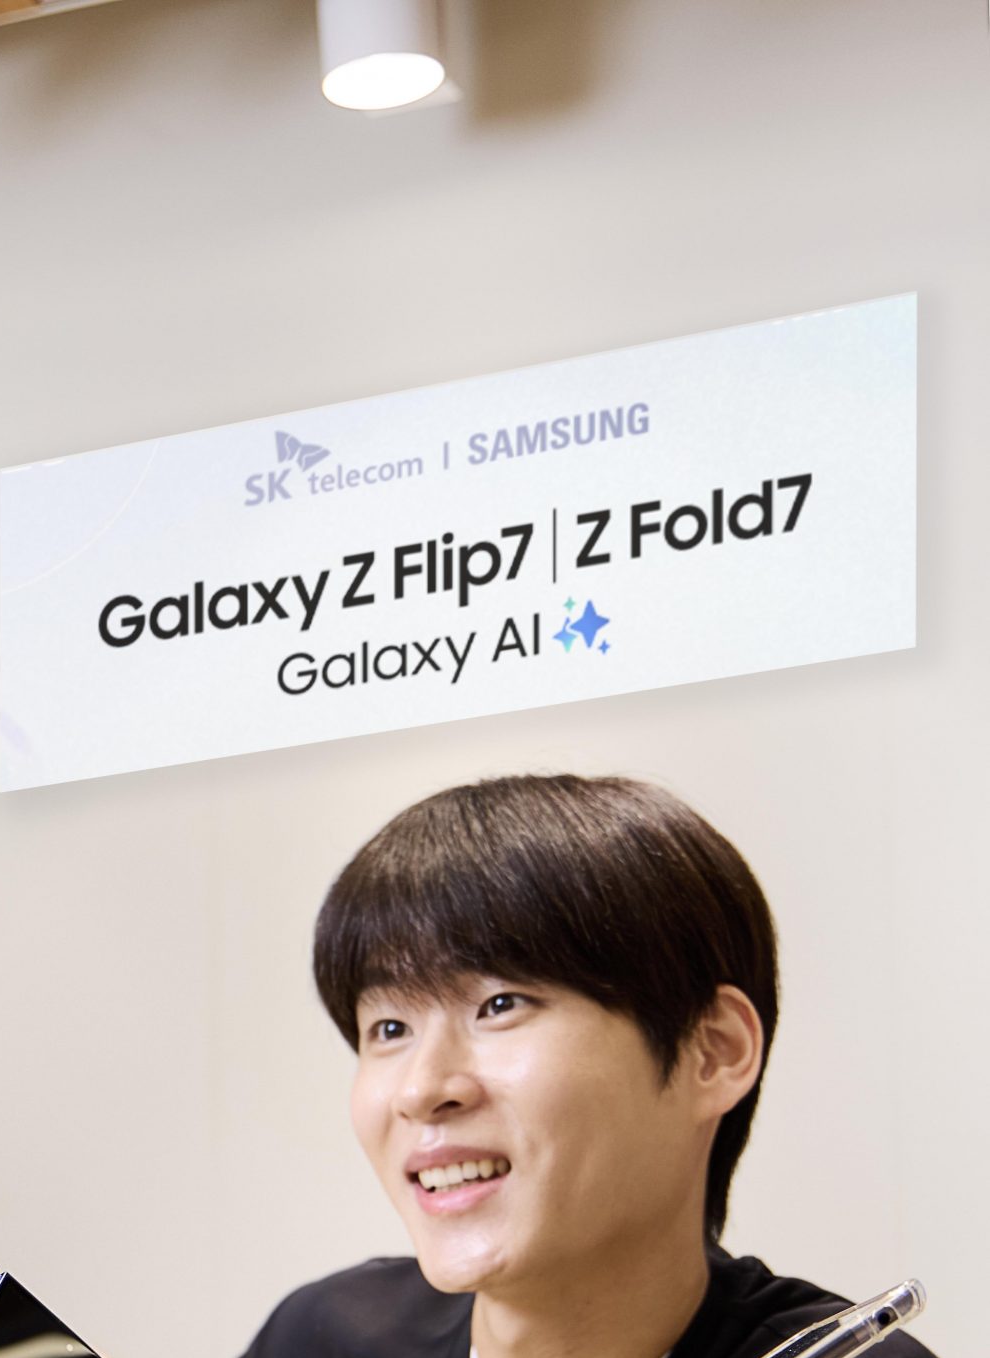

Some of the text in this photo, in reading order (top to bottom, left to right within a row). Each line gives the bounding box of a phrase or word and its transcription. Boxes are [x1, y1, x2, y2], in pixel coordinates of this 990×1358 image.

[244, 402, 650, 507] SK telecom SAMSUNG
[98, 473, 812, 647] Galaxy Z Flip7 Z Fold7
[277, 613, 540, 695] Galaxy AI
